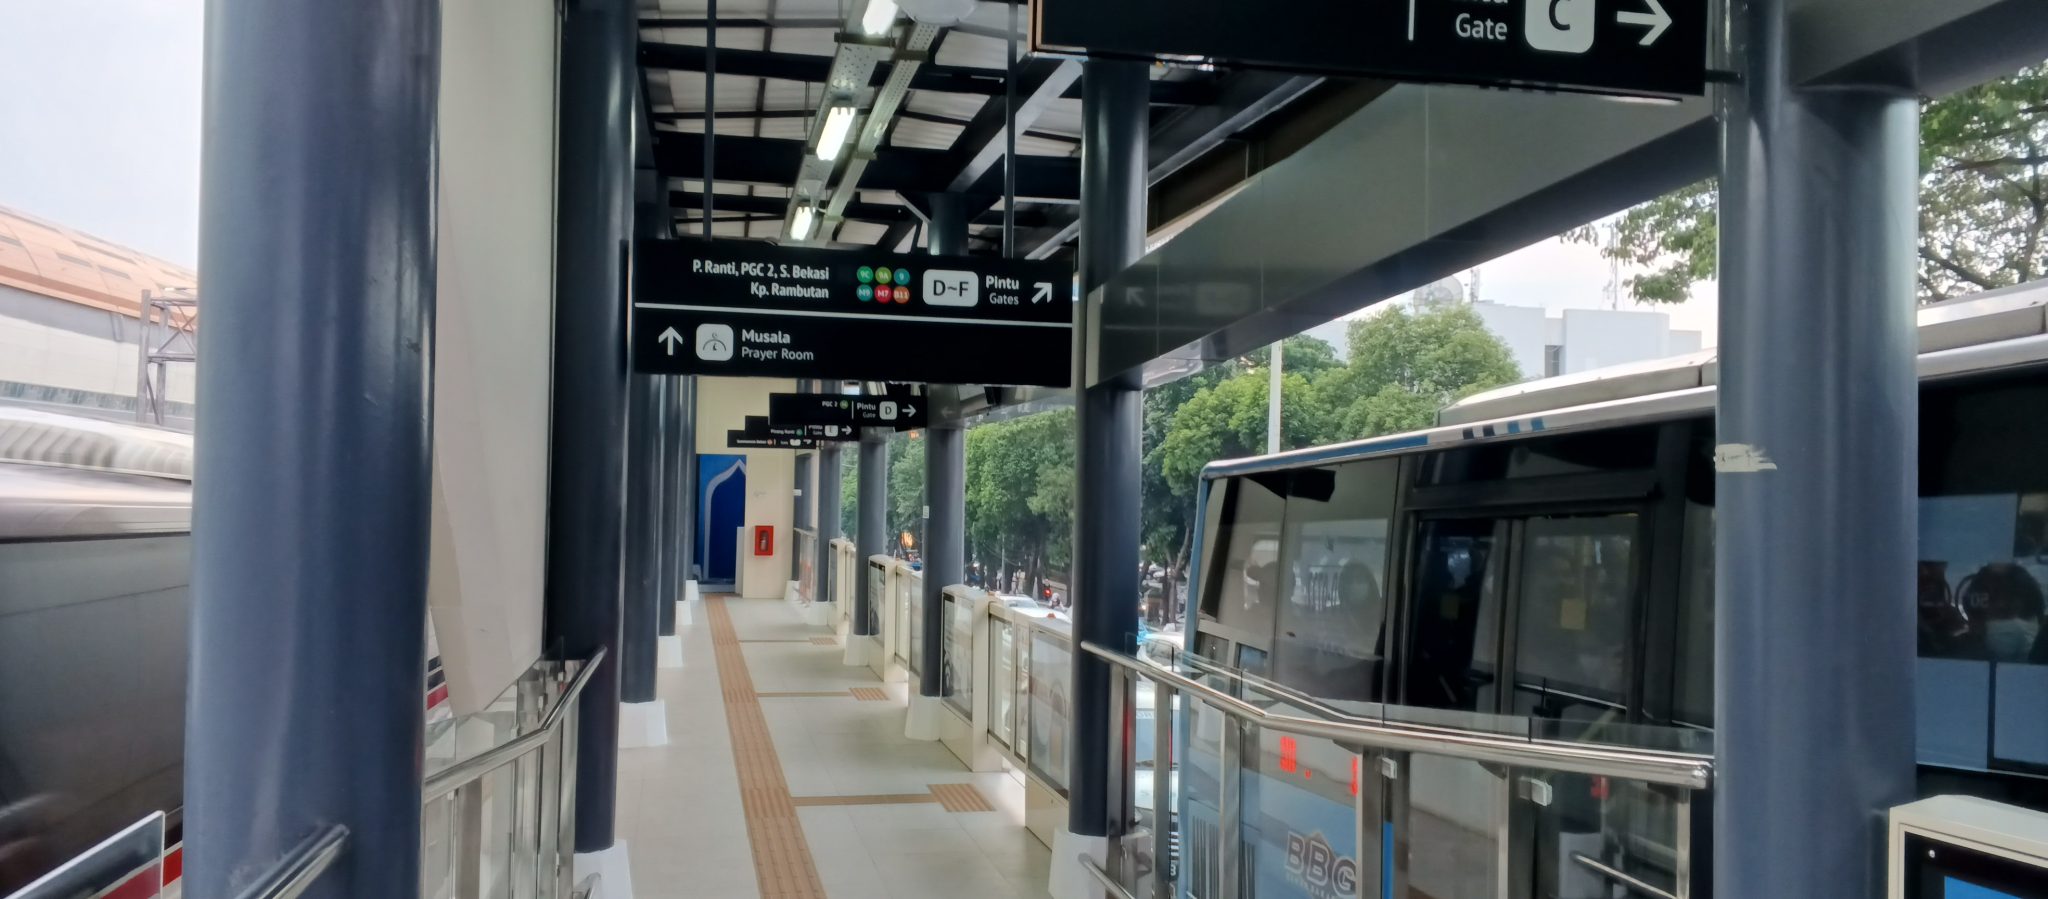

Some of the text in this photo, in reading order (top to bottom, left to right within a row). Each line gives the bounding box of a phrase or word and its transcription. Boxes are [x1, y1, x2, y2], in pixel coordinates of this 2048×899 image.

[1548, 0, 1571, 31] C
[1455, 12, 1508, 40] Gate
[692, 259, 829, 280] P. Ranti, PGC 2, S. Bekasi
[985, 274, 1020, 290] Pintu
[750, 282, 829, 299] Kp. Rambutan
[989, 293, 1020, 305] Gates
[741, 328, 791, 344] Musala
[741, 346, 814, 361] Prayer Room
[856, 402, 876, 411] Pintu
[885, 406, 892, 415] D
[1285, 831, 1357, 898] BBG
